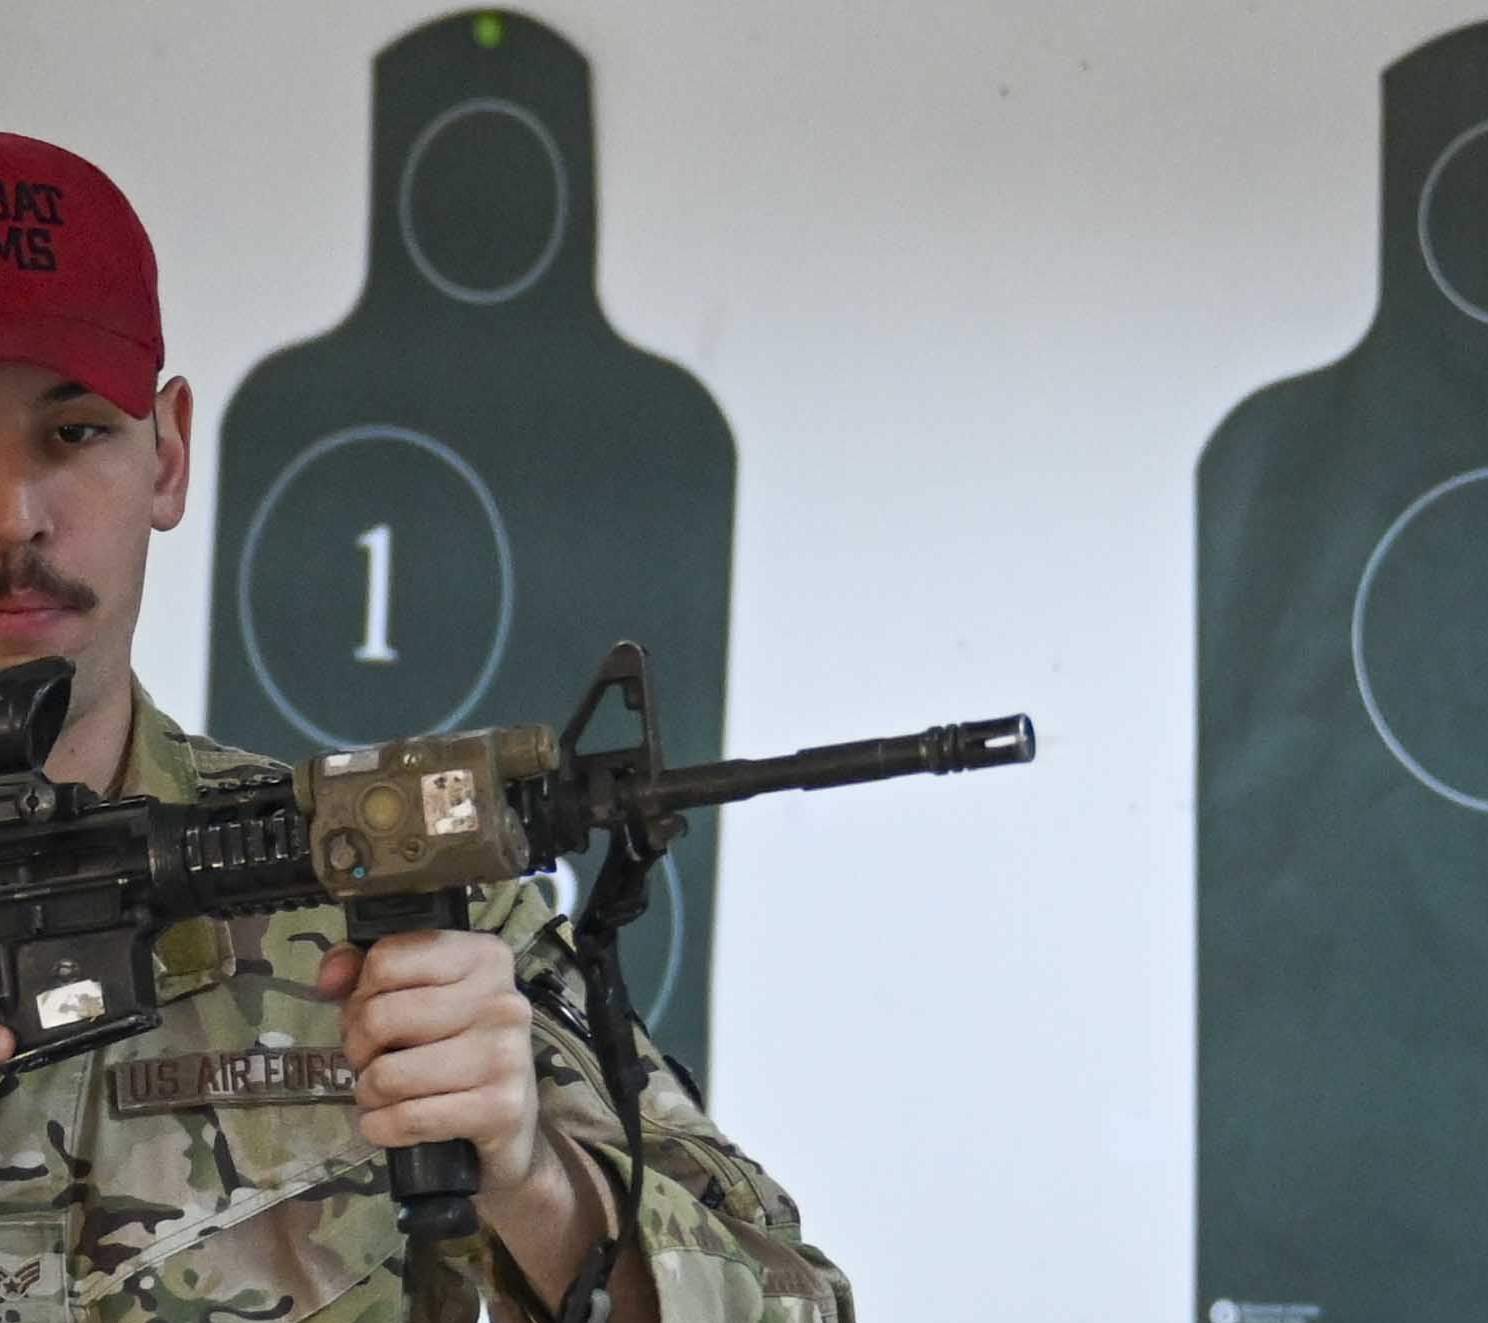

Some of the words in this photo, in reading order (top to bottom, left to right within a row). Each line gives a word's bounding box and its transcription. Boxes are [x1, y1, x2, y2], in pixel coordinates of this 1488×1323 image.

[354, 523, 399, 662] 1
[128, 1062, 179, 1100] US
[197, 1054, 252, 1094] AIR
[264, 1051, 358, 1091] FORC
